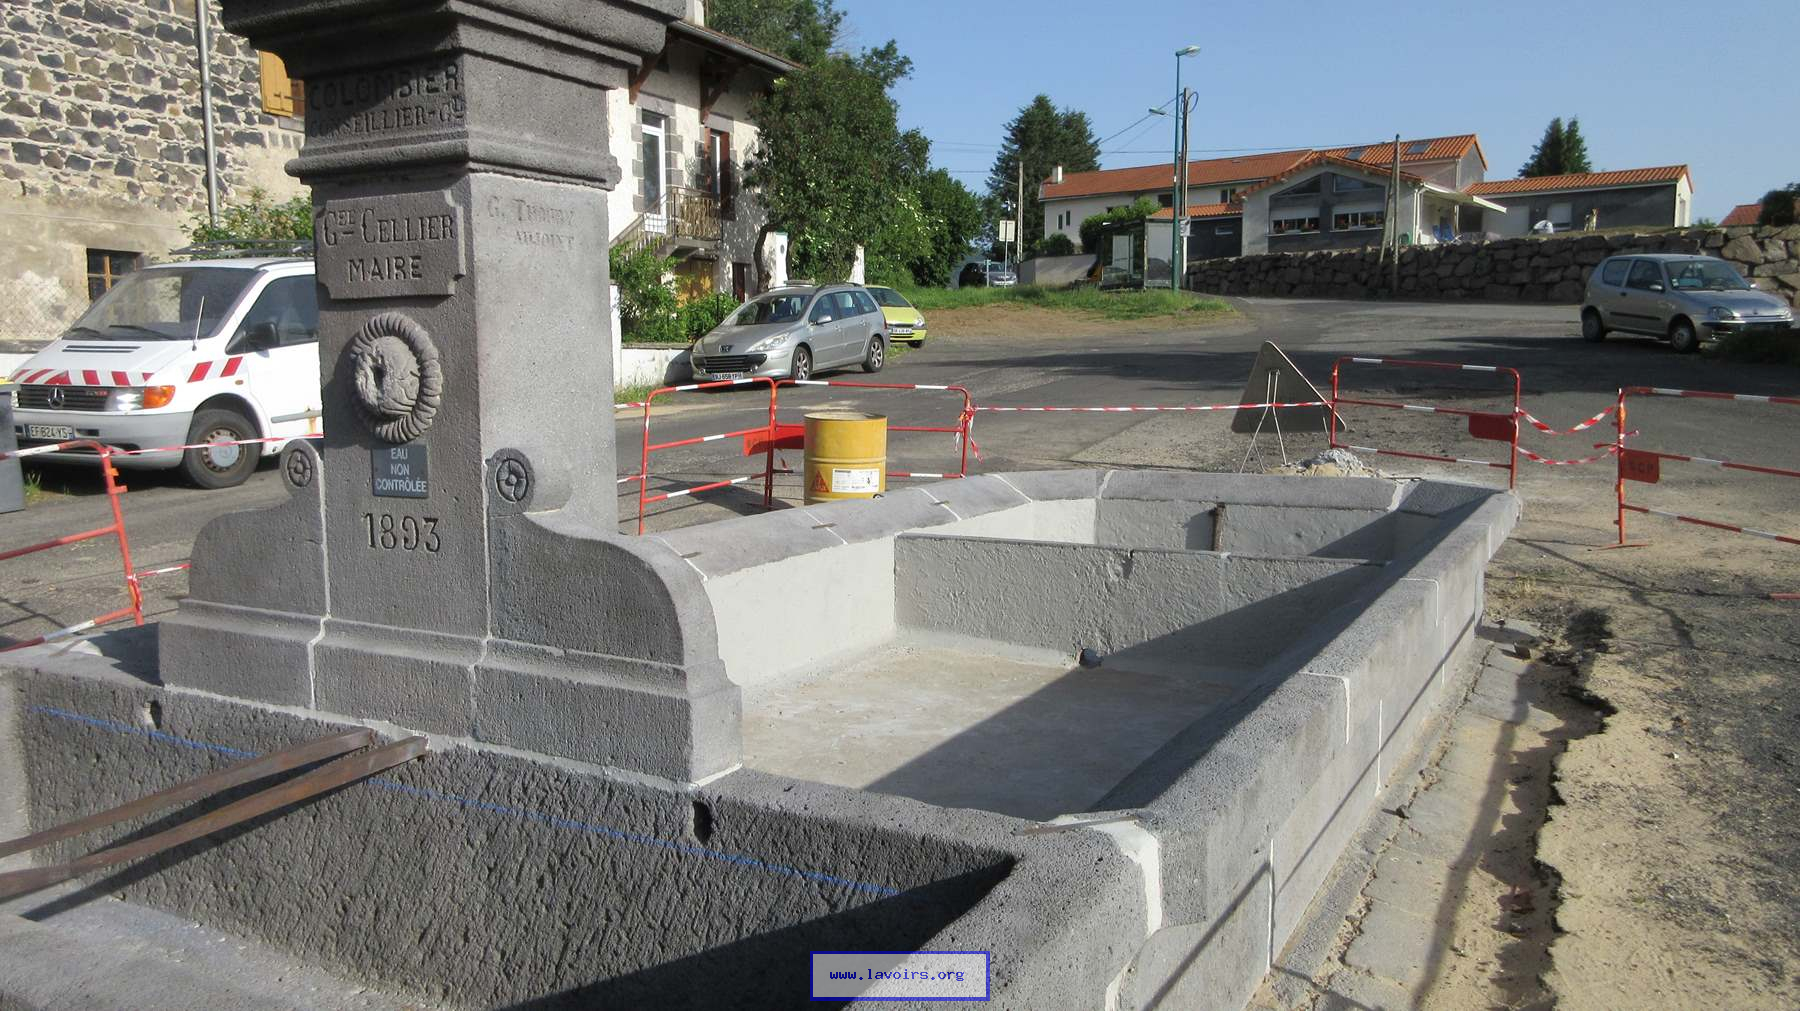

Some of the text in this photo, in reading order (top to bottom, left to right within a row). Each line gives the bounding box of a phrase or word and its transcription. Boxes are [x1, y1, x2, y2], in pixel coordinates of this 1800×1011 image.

[361, 208, 455, 244] CELLIER
[348, 255, 423, 283] MAIRE
[391, 448, 408, 459] EAU
[390, 464, 410, 475] NON
[375, 477, 427, 493] CONTRÔLÉE
[361, 512, 441, 553] 1893
